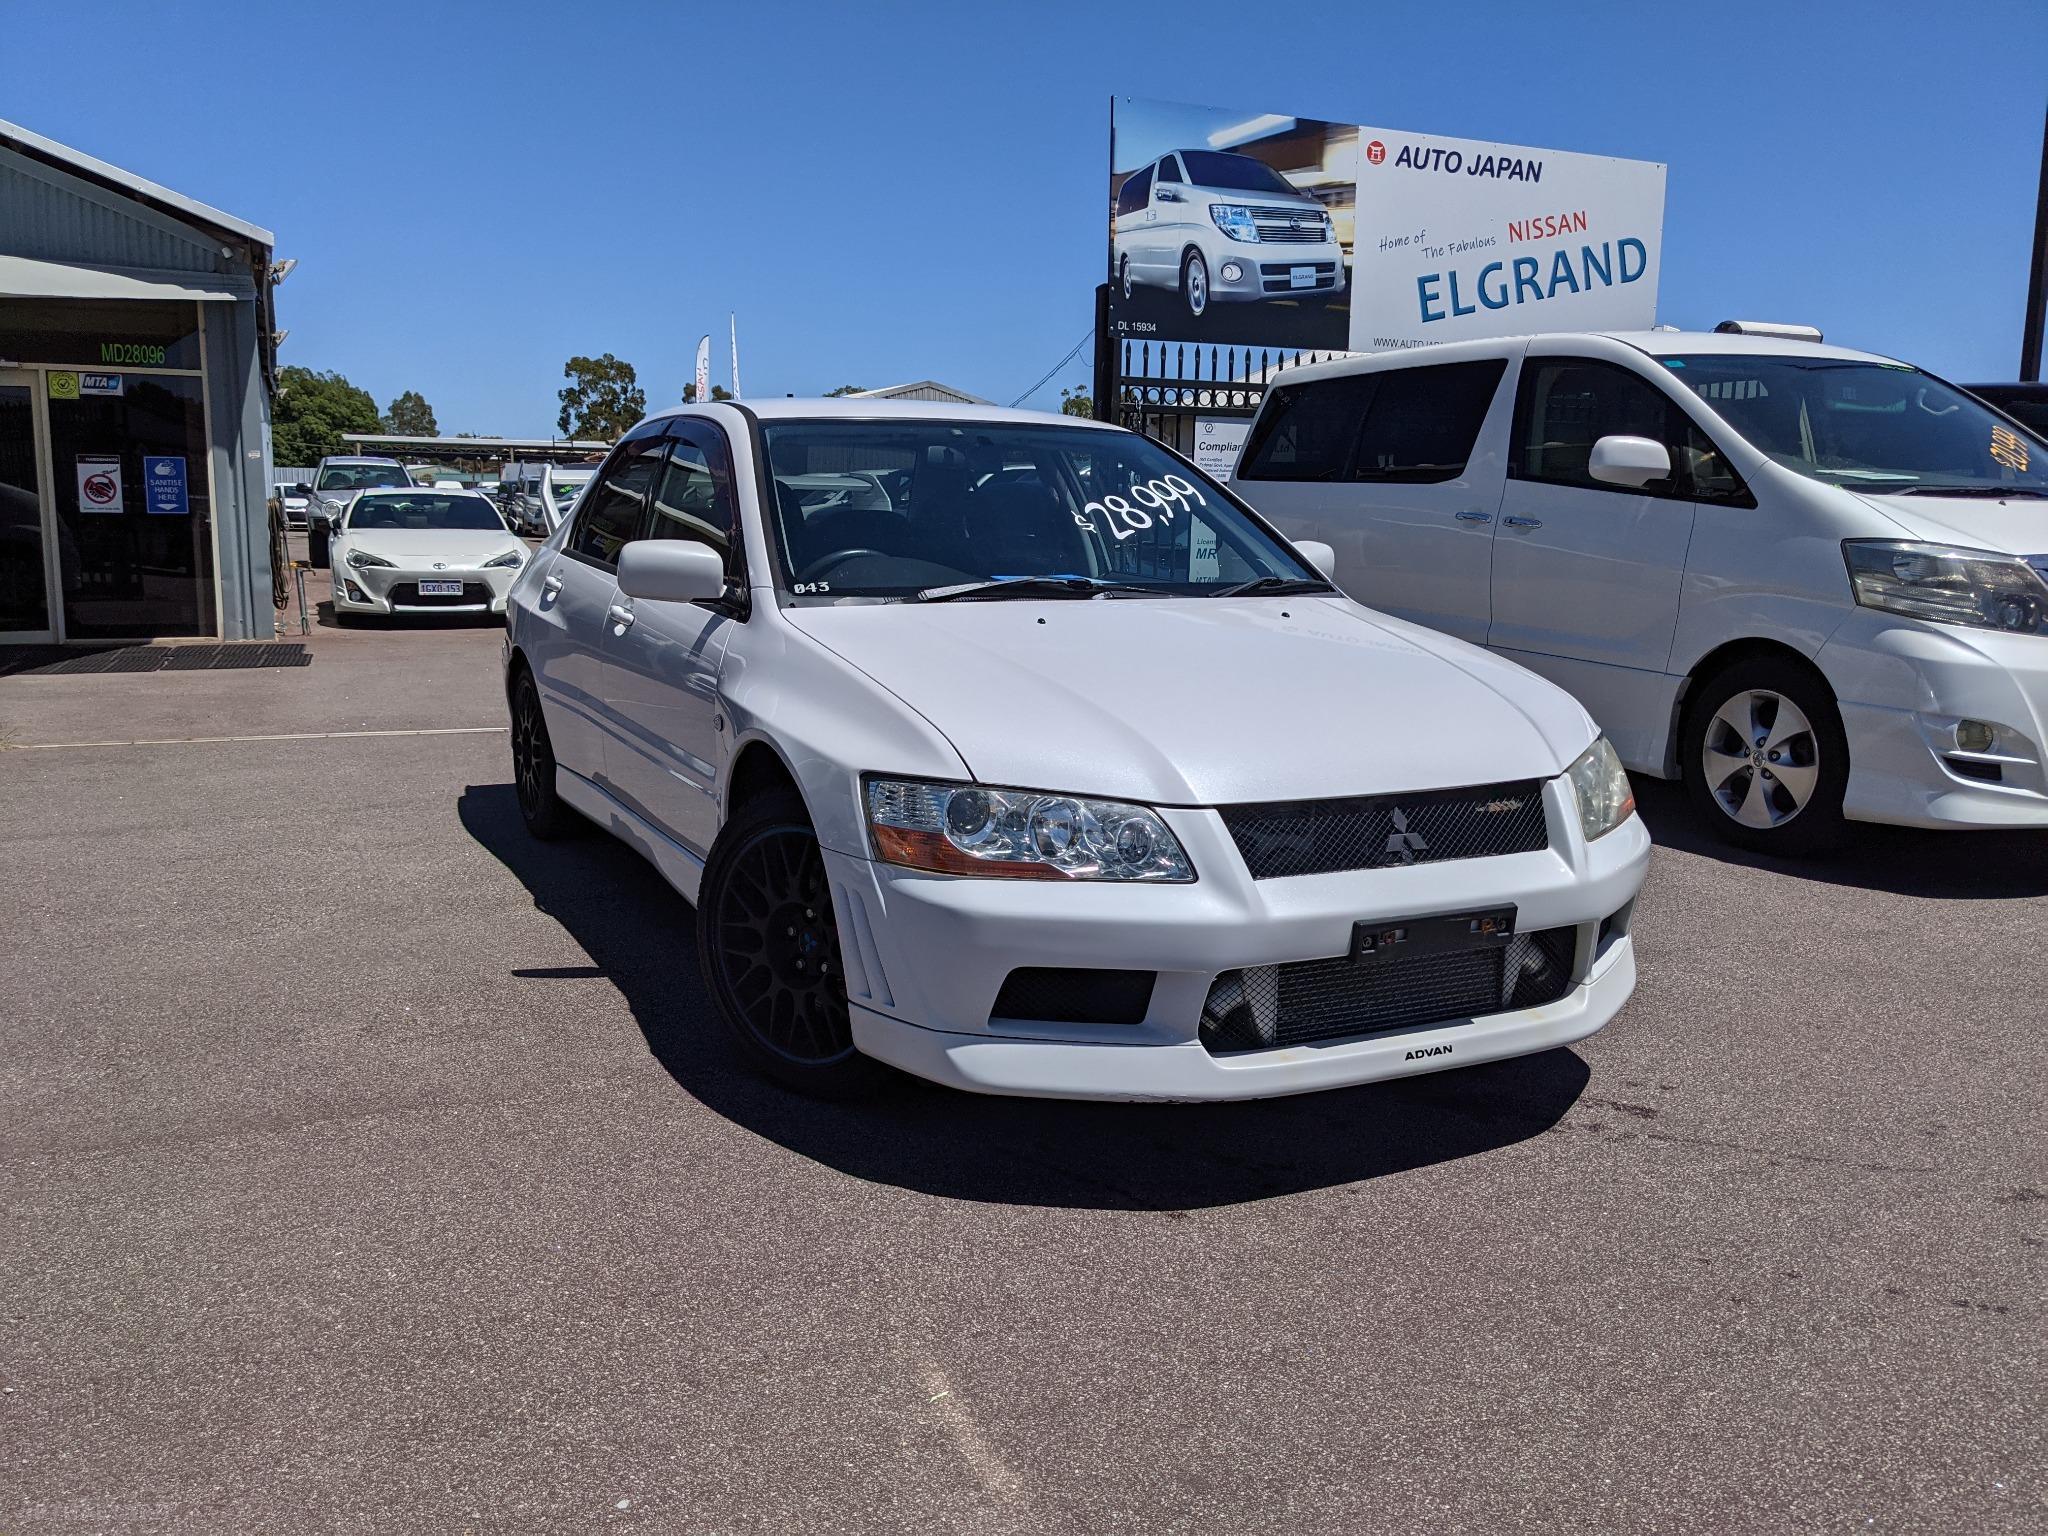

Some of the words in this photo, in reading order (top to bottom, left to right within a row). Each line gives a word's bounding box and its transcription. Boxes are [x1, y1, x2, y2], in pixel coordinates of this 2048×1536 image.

[1395, 145, 1462, 174] AUTO
[1467, 154, 1542, 183] JAPAN
[1508, 210, 1587, 243] NISSAN
[1379, 235, 1410, 252] Home
[1414, 229, 1426, 245] of
[1421, 246, 1444, 259] The
[1448, 235, 1497, 256] Fabulous
[1417, 237, 1647, 323] ELGRAND
[1117, 321, 1129, 331] DL
[1132, 322, 1156, 332] 15934
[101, 343, 166, 364] MD28096
[84, 376, 108, 387] MTA
[150, 479, 183, 487] SANITISE
[154, 486, 179, 494] HANDS
[1071, 475, 1207, 540] $28,999
[794, 581, 830, 594] 043
[1405, 1044, 1453, 1061] ADVAN
